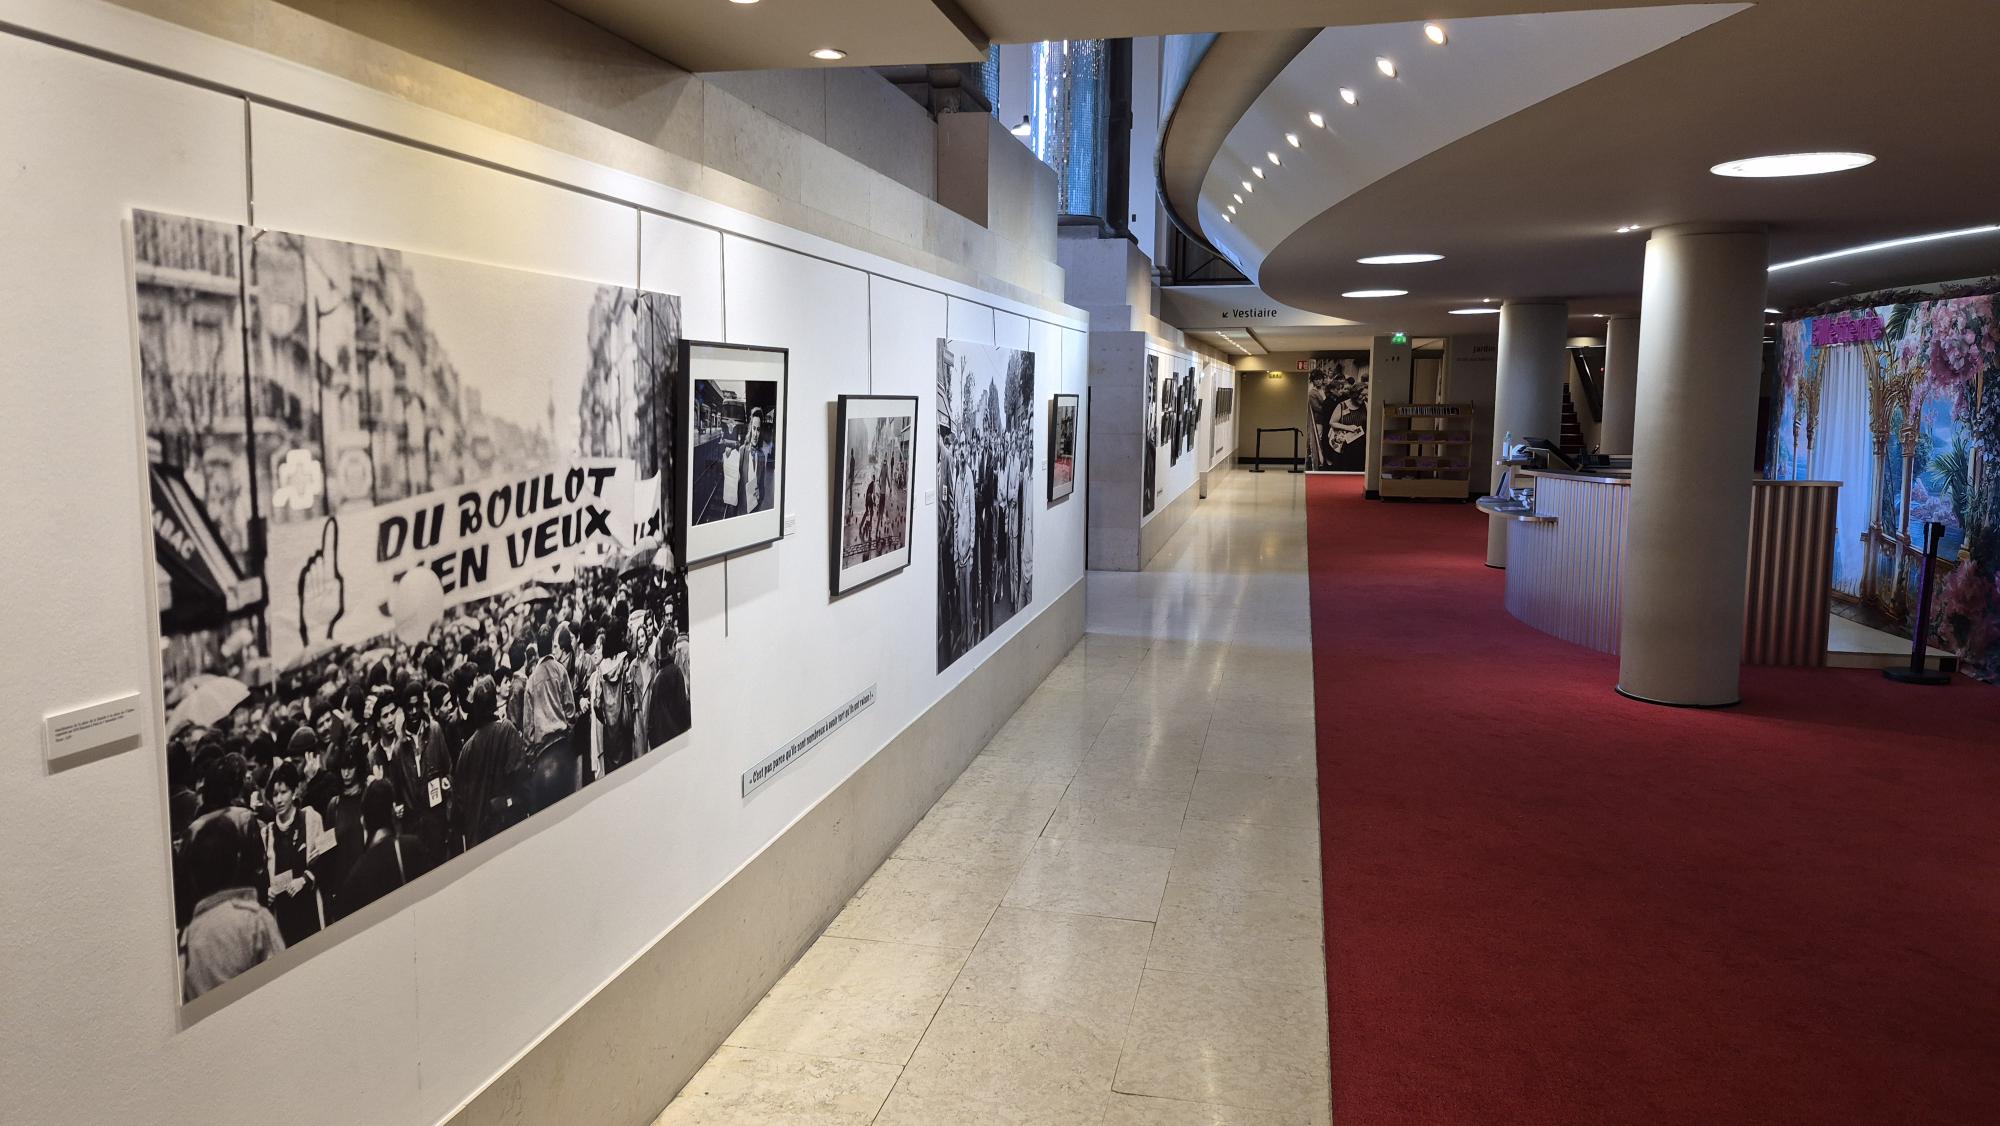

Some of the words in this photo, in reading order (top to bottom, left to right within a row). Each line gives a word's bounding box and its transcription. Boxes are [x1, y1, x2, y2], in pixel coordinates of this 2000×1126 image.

[1232, 308, 1277, 318] Vestiaire
[376, 503, 445, 563] DU
[457, 467, 616, 537] BOULOT
[506, 505, 612, 569] VEUX
[764, 763, 772, 777] pas
[772, 754, 785, 772] parce
[807, 725, 825, 745] nombreux
